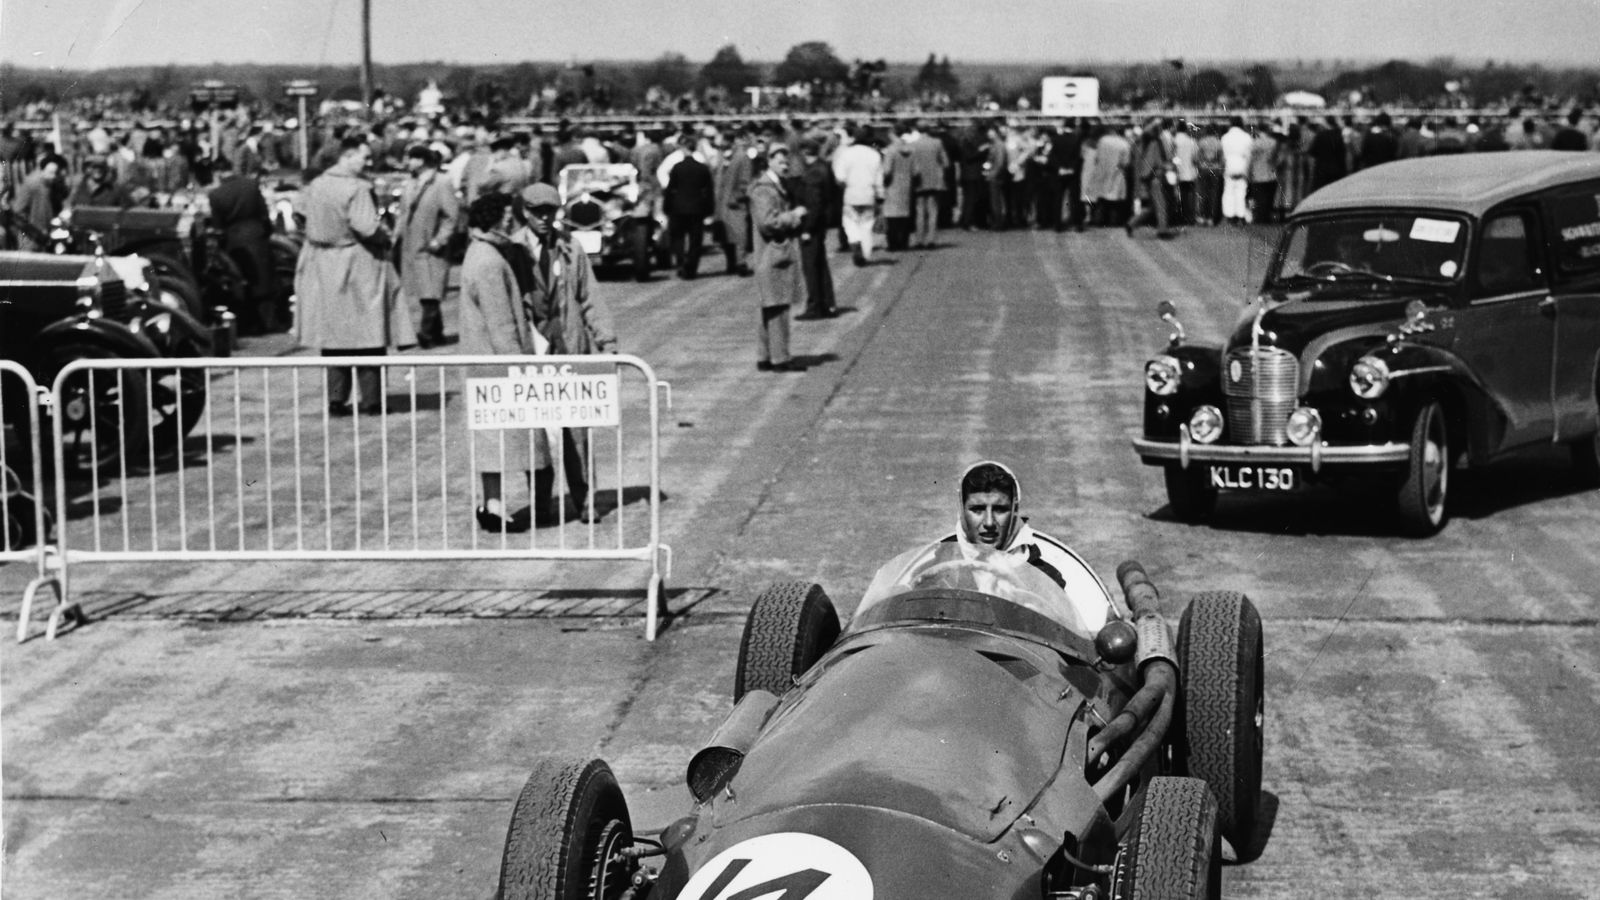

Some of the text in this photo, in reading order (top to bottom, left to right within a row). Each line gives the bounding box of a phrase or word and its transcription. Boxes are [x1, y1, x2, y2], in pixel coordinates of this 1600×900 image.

[475, 380, 607, 404] NO PARKING
[474, 404, 610, 424] BEYOND THIS POINT
[1210, 465, 1293, 490] KLC 130
